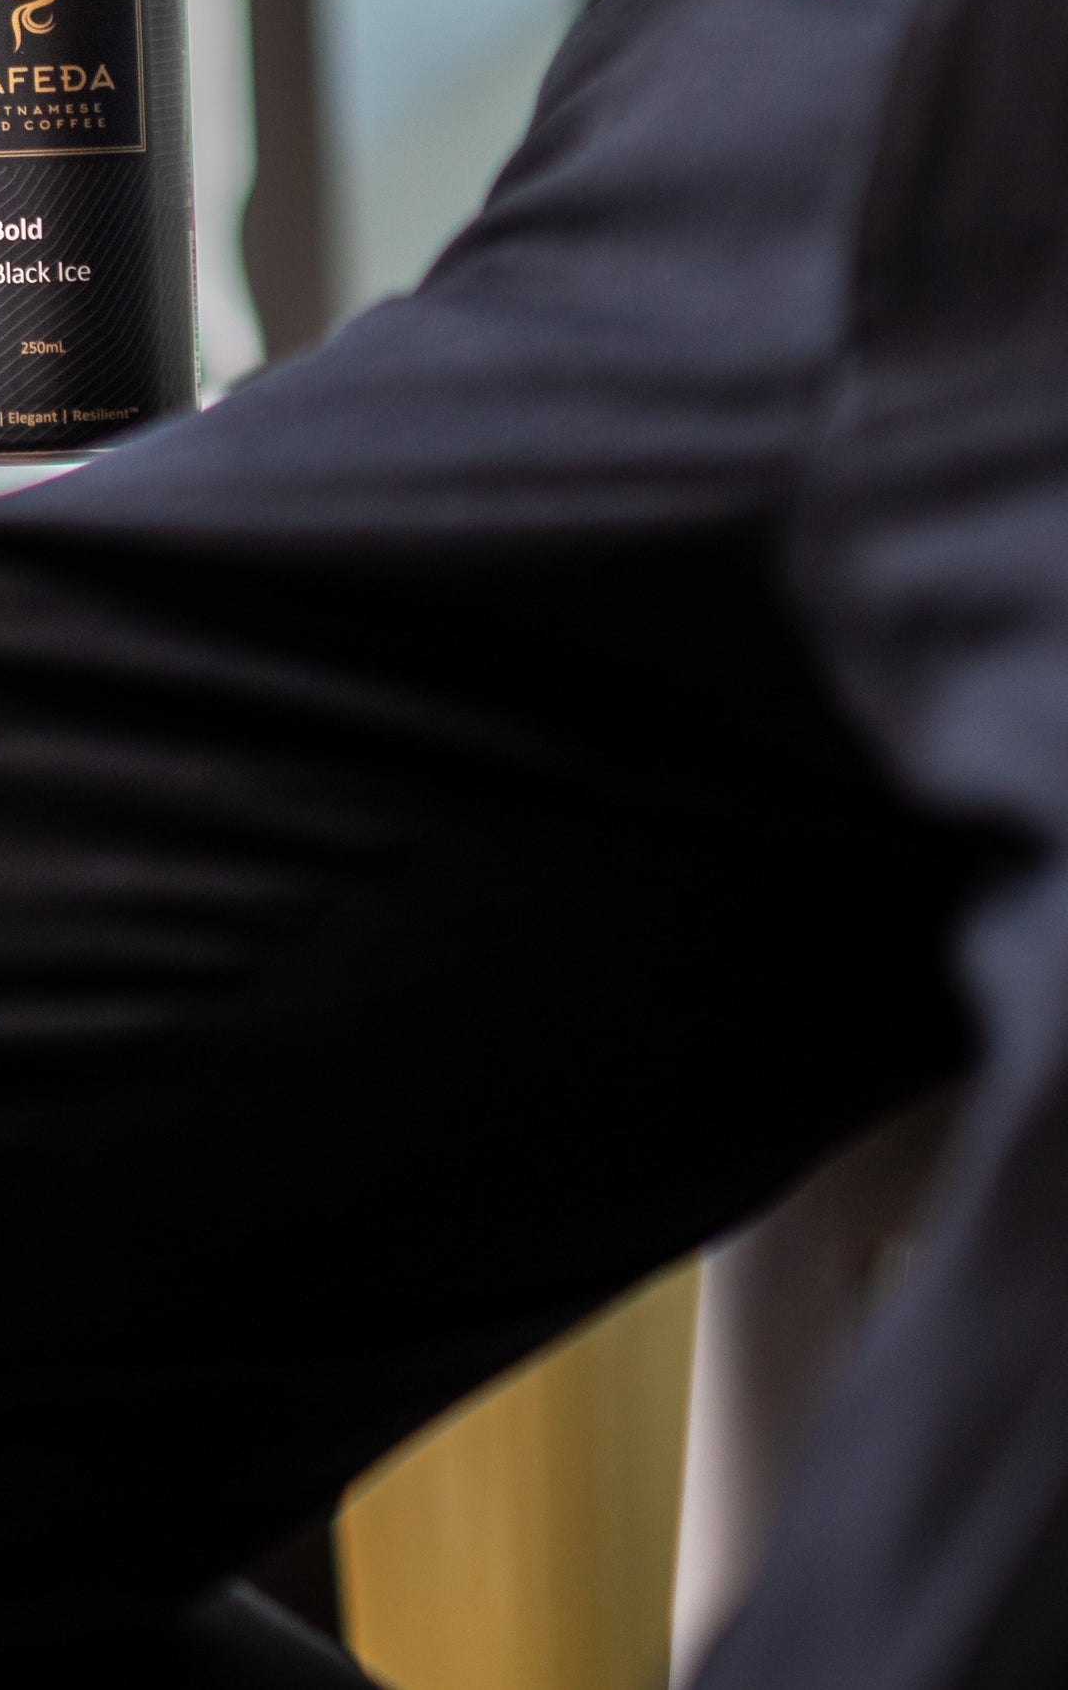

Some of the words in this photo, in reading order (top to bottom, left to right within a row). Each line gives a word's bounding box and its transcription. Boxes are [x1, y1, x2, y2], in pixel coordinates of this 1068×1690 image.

[24, 118, 107, 132] COFFEE
[57, 262, 92, 283] Ice
[20, 340, 67, 356] 250mL
[7, 411, 58, 427] Elegant
